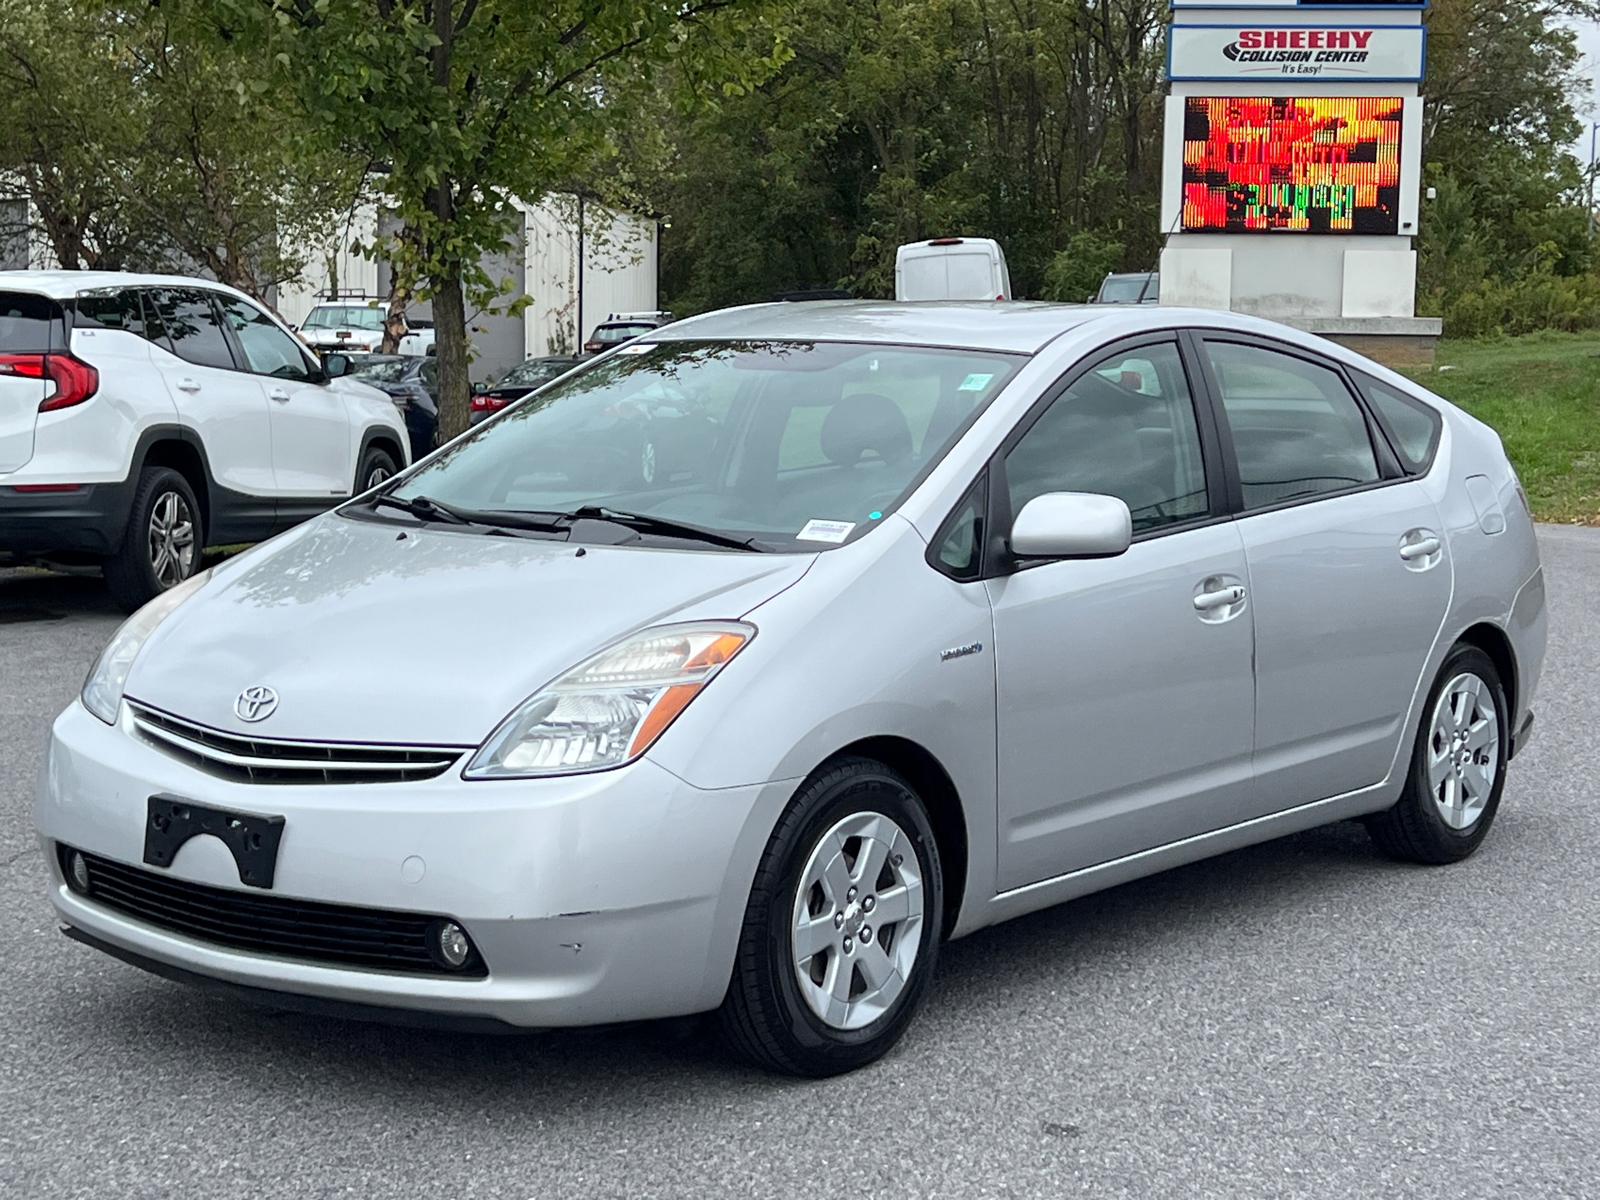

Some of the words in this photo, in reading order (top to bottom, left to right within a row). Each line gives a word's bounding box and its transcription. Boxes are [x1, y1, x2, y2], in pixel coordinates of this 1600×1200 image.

[1239, 31, 1373, 48] SHEEHY
[1239, 51, 1311, 62] COLLISION
[1314, 51, 1368, 62] CENTER
[1281, 64, 1296, 74] It's
[1297, 64, 1322, 75] Easy!
